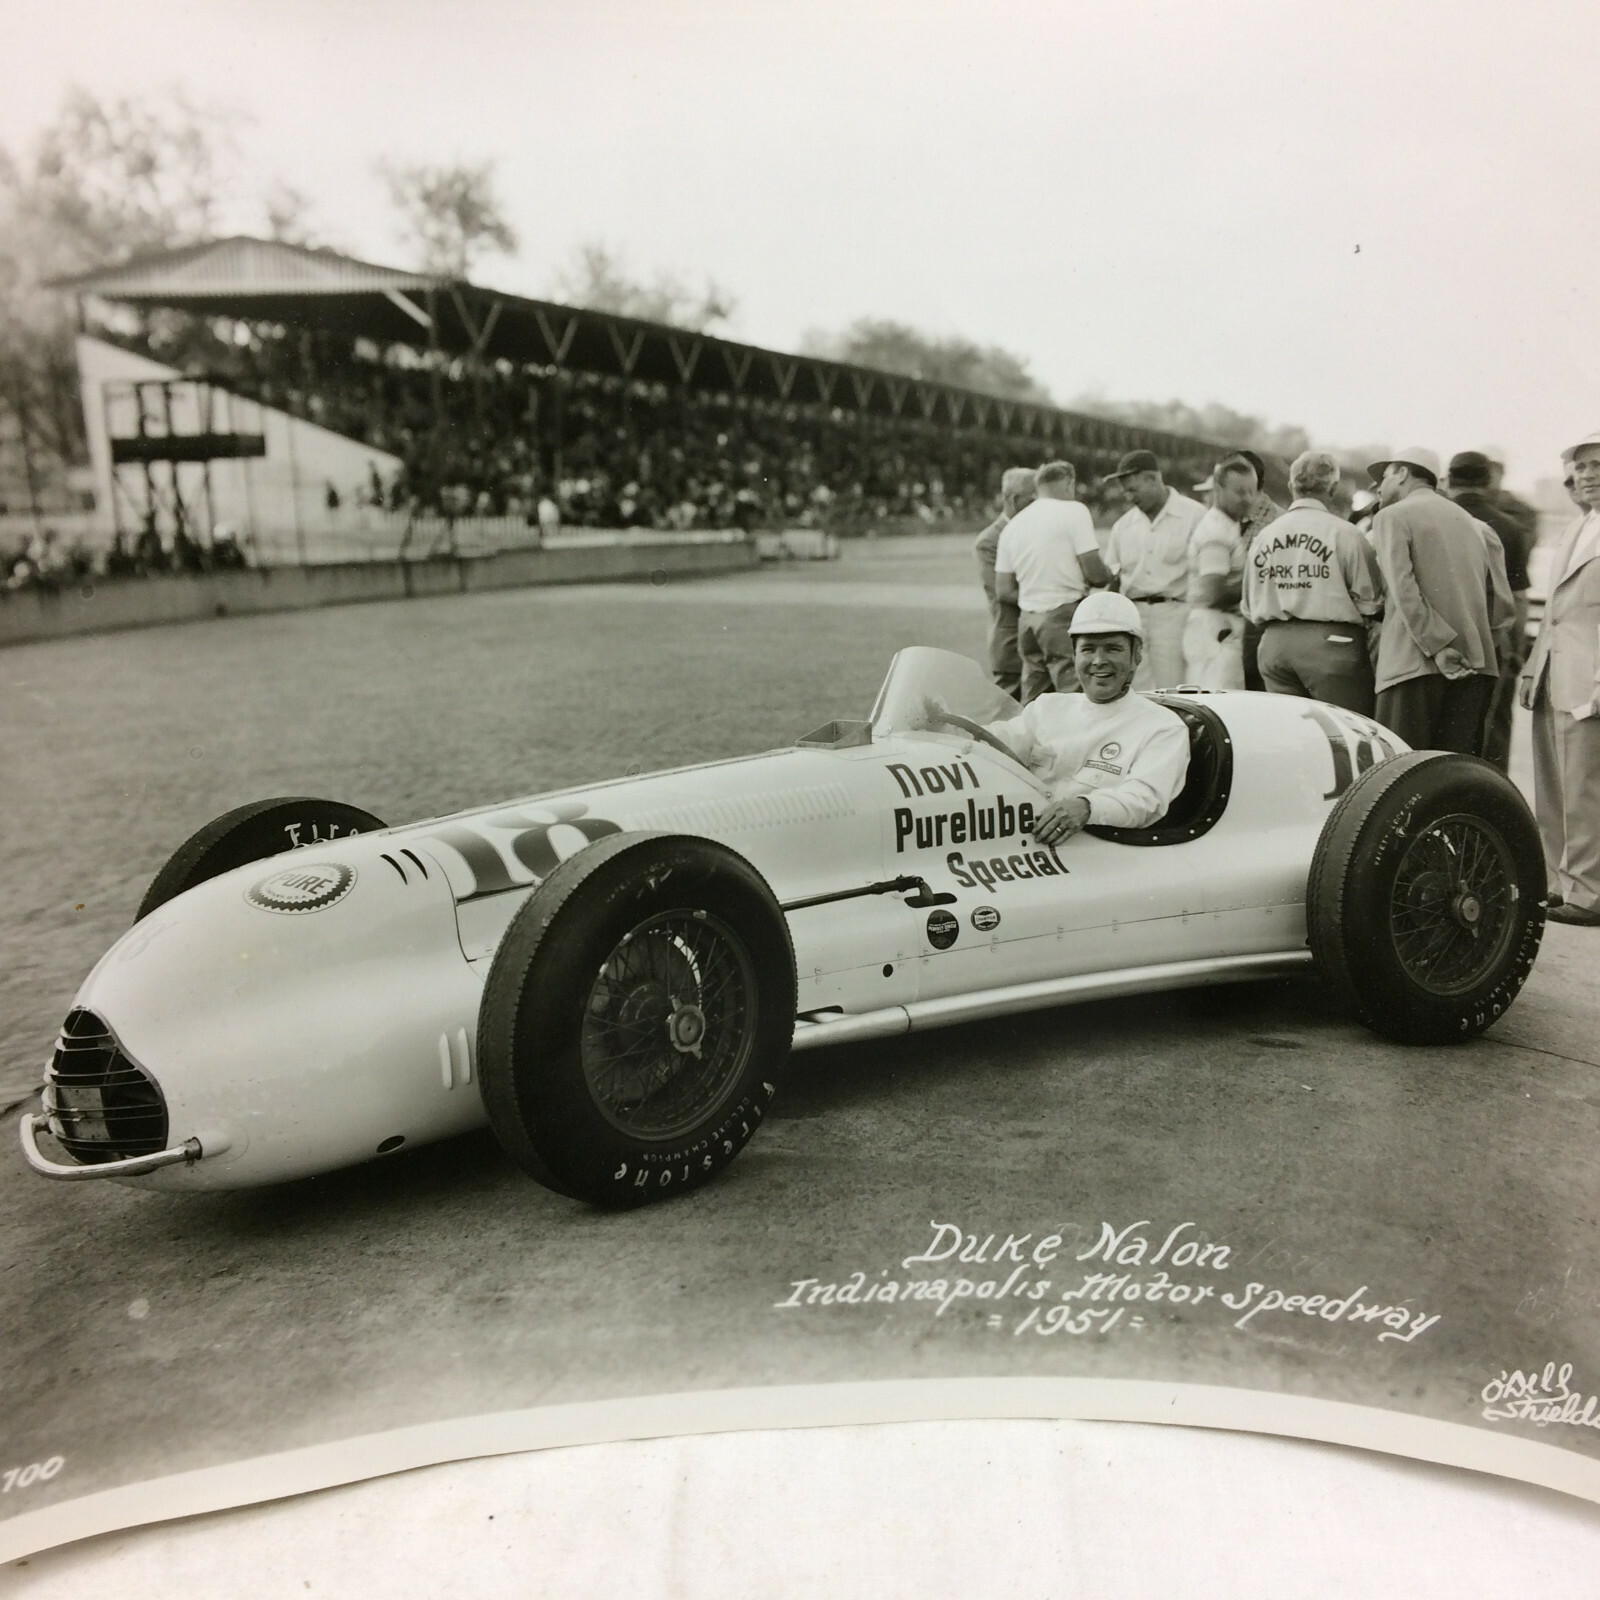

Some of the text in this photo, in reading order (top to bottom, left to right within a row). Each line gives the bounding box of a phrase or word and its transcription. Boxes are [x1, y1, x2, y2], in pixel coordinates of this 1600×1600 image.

[1254, 534, 1333, 568] CHAMPION
[1259, 564, 1330, 580] SPARK PLUG
[1275, 582, 1312, 590] WINING
[894, 795, 1036, 853] Purelube
[428, 802, 623, 902] 18
[947, 840, 1070, 893] Special
[270, 874, 333, 895] PURE
[711, 1097, 750, 1141] DELUXE
[902, 1219, 1062, 1269] Duke
[1076, 1220, 1231, 1269] Nalon
[773, 1264, 1441, 1342] Indianapolis Motor Speedway
